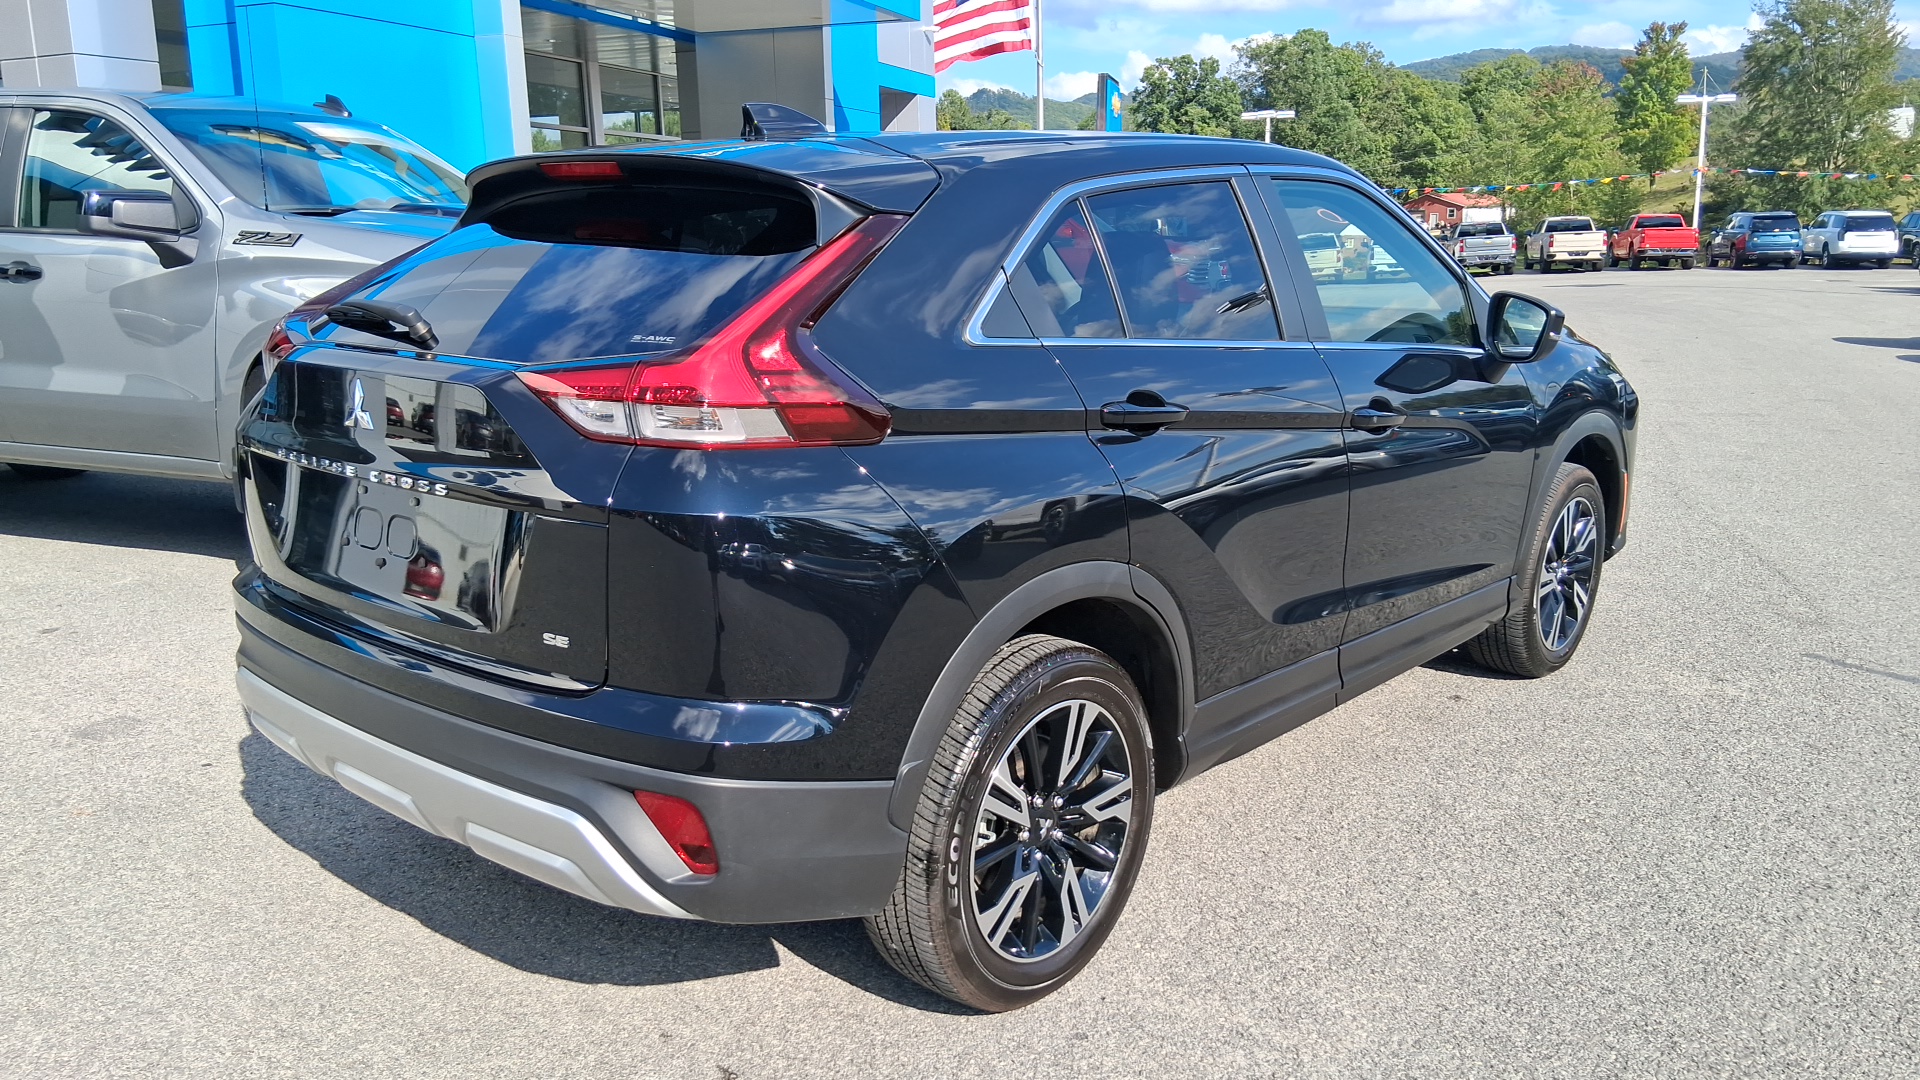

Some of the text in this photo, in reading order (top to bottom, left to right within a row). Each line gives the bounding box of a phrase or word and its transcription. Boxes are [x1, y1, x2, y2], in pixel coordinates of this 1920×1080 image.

[232, 230, 303, 247] Z71
[369, 470, 449, 496] CROSS
[542, 632, 570, 649] SE
